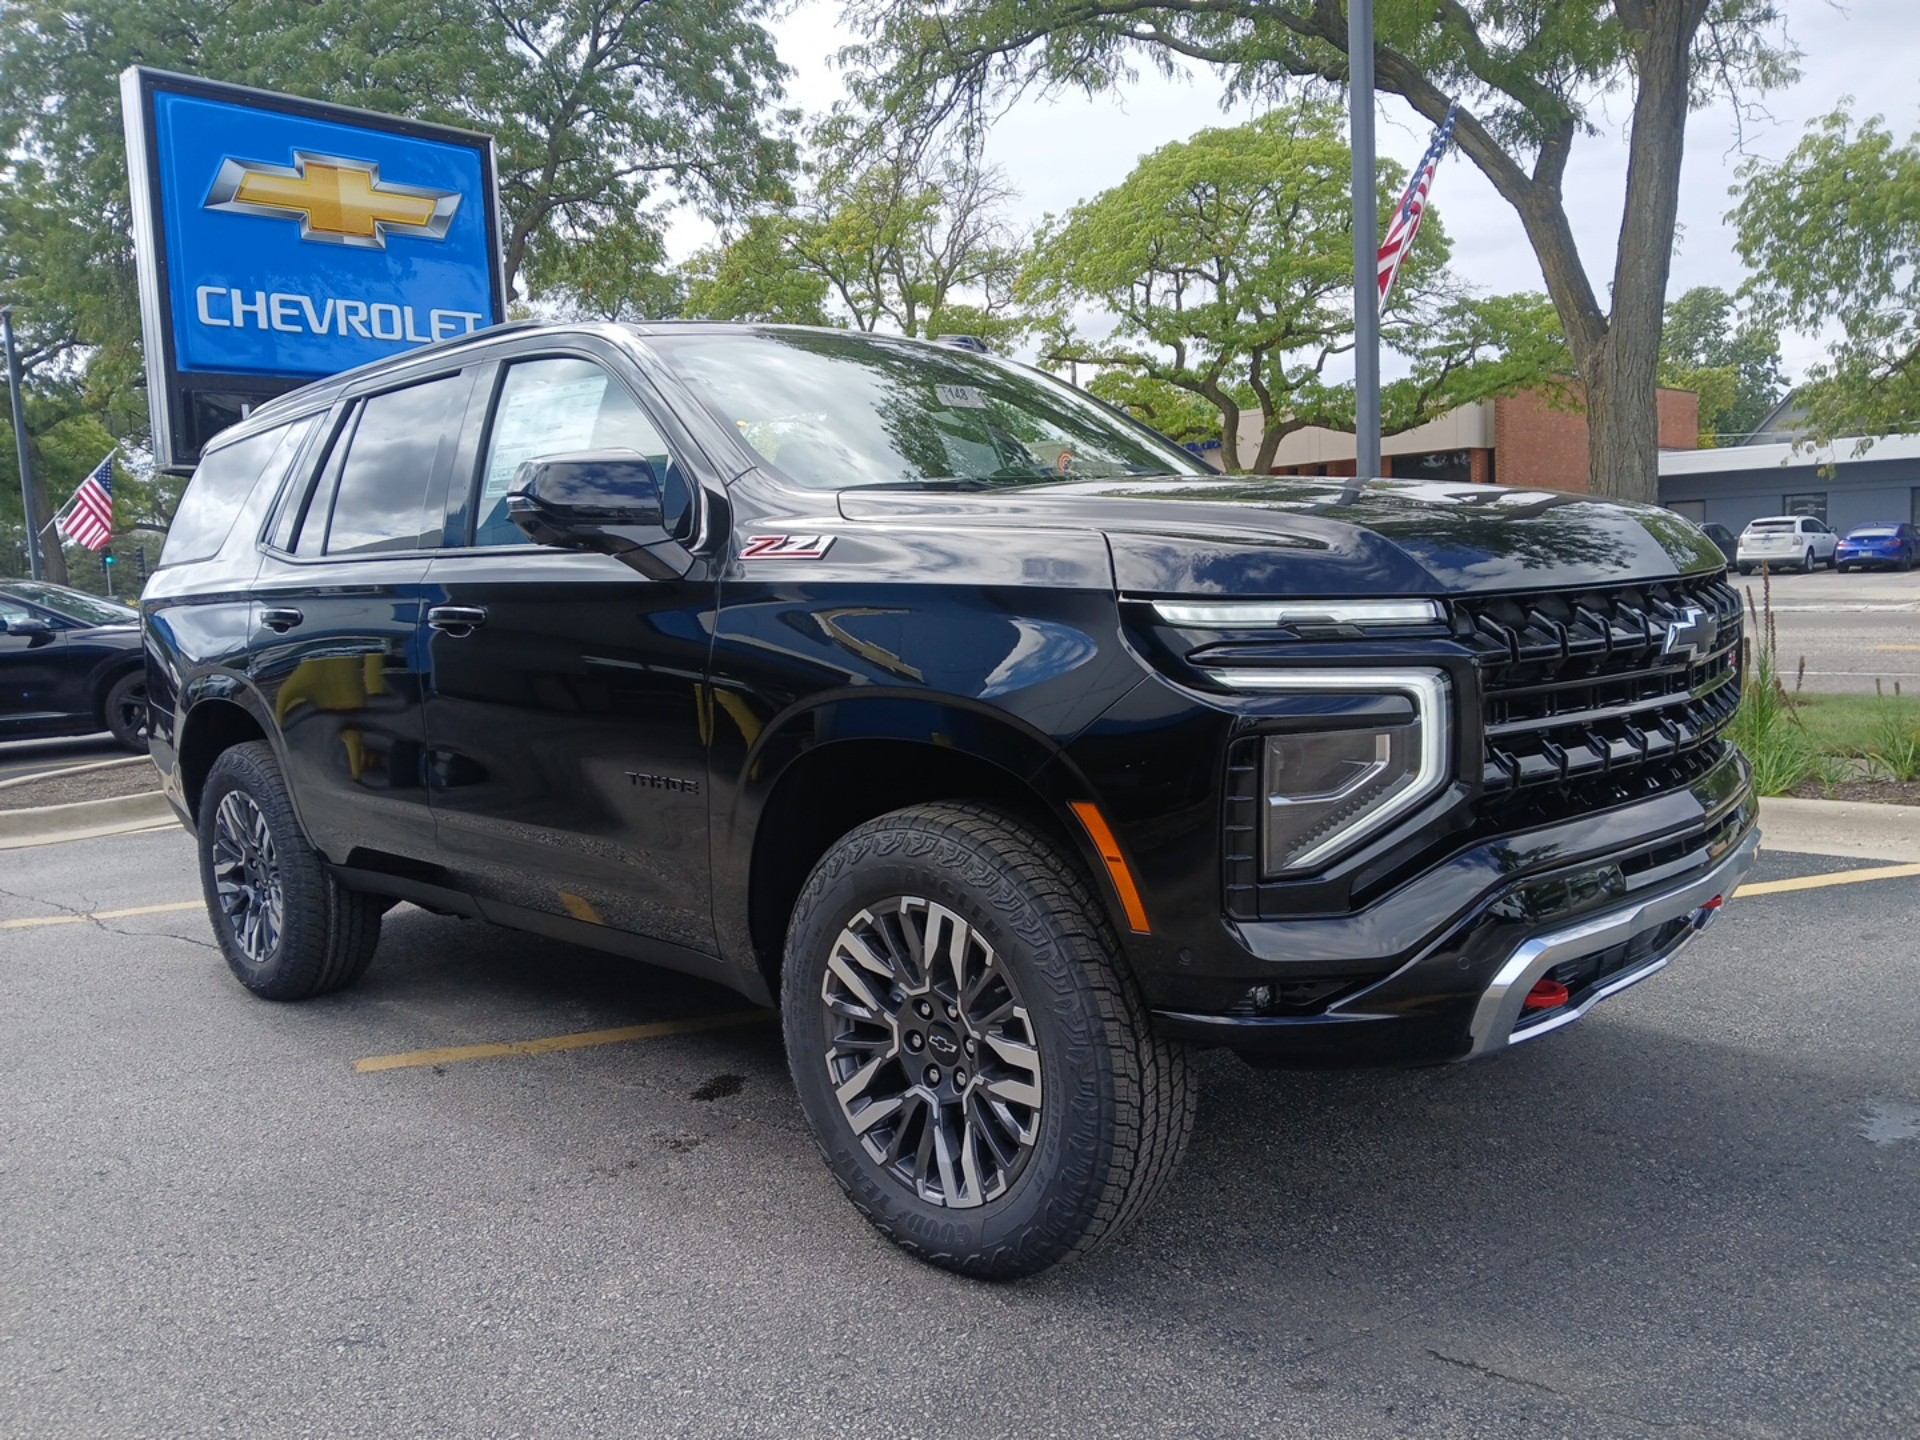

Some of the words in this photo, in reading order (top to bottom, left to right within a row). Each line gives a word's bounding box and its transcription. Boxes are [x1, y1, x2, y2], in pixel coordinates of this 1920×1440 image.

[196, 286, 483, 343] CHEVROLET
[738, 534, 838, 560] Z71
[624, 771, 699, 794] TAHOE
[860, 864, 1003, 937] RANGLER
